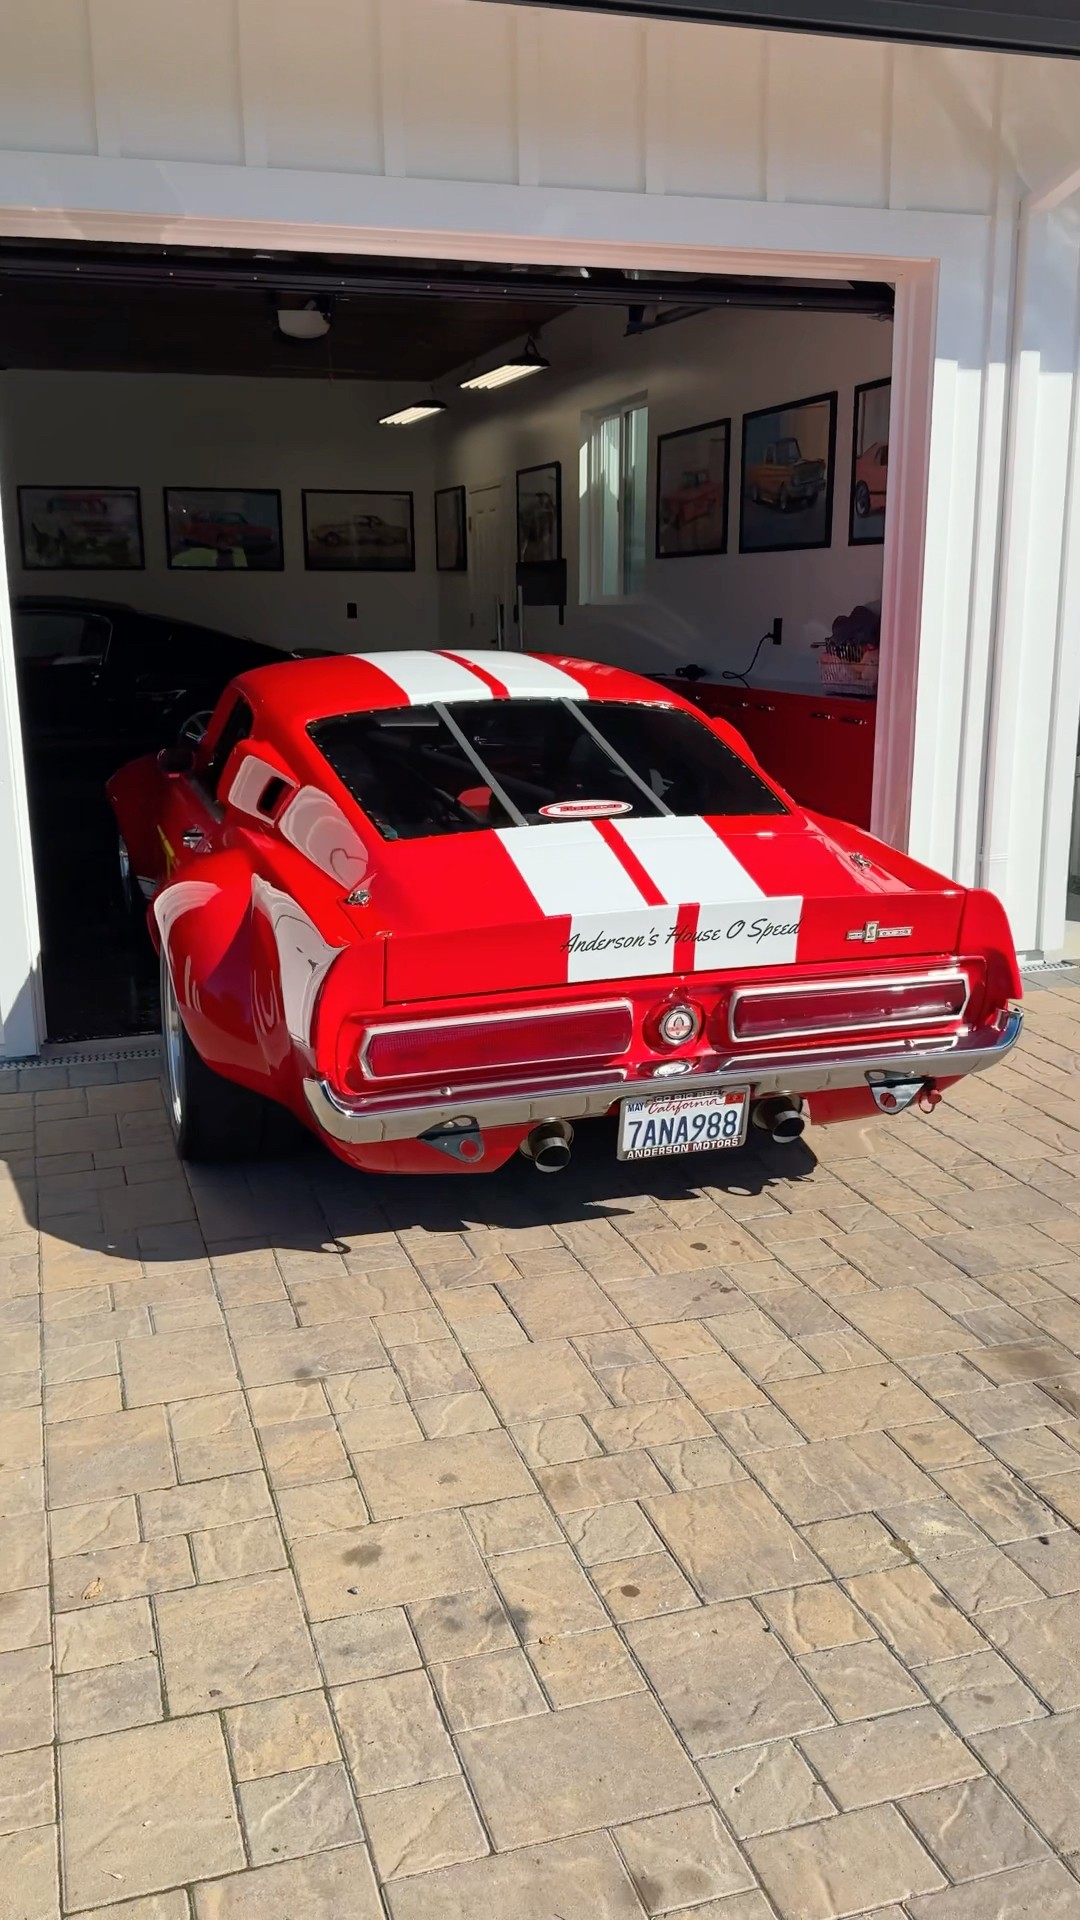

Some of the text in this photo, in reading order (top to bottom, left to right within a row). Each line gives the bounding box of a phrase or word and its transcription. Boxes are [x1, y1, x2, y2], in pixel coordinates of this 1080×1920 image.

[560, 916, 804, 954] Anderson's House O Speed
[627, 1102, 644, 1113] MAY
[647, 1098, 723, 1116] California
[628, 1109, 738, 1149] 7ANA988
[627, 1137, 739, 1160] ANDERSON MOTORS
